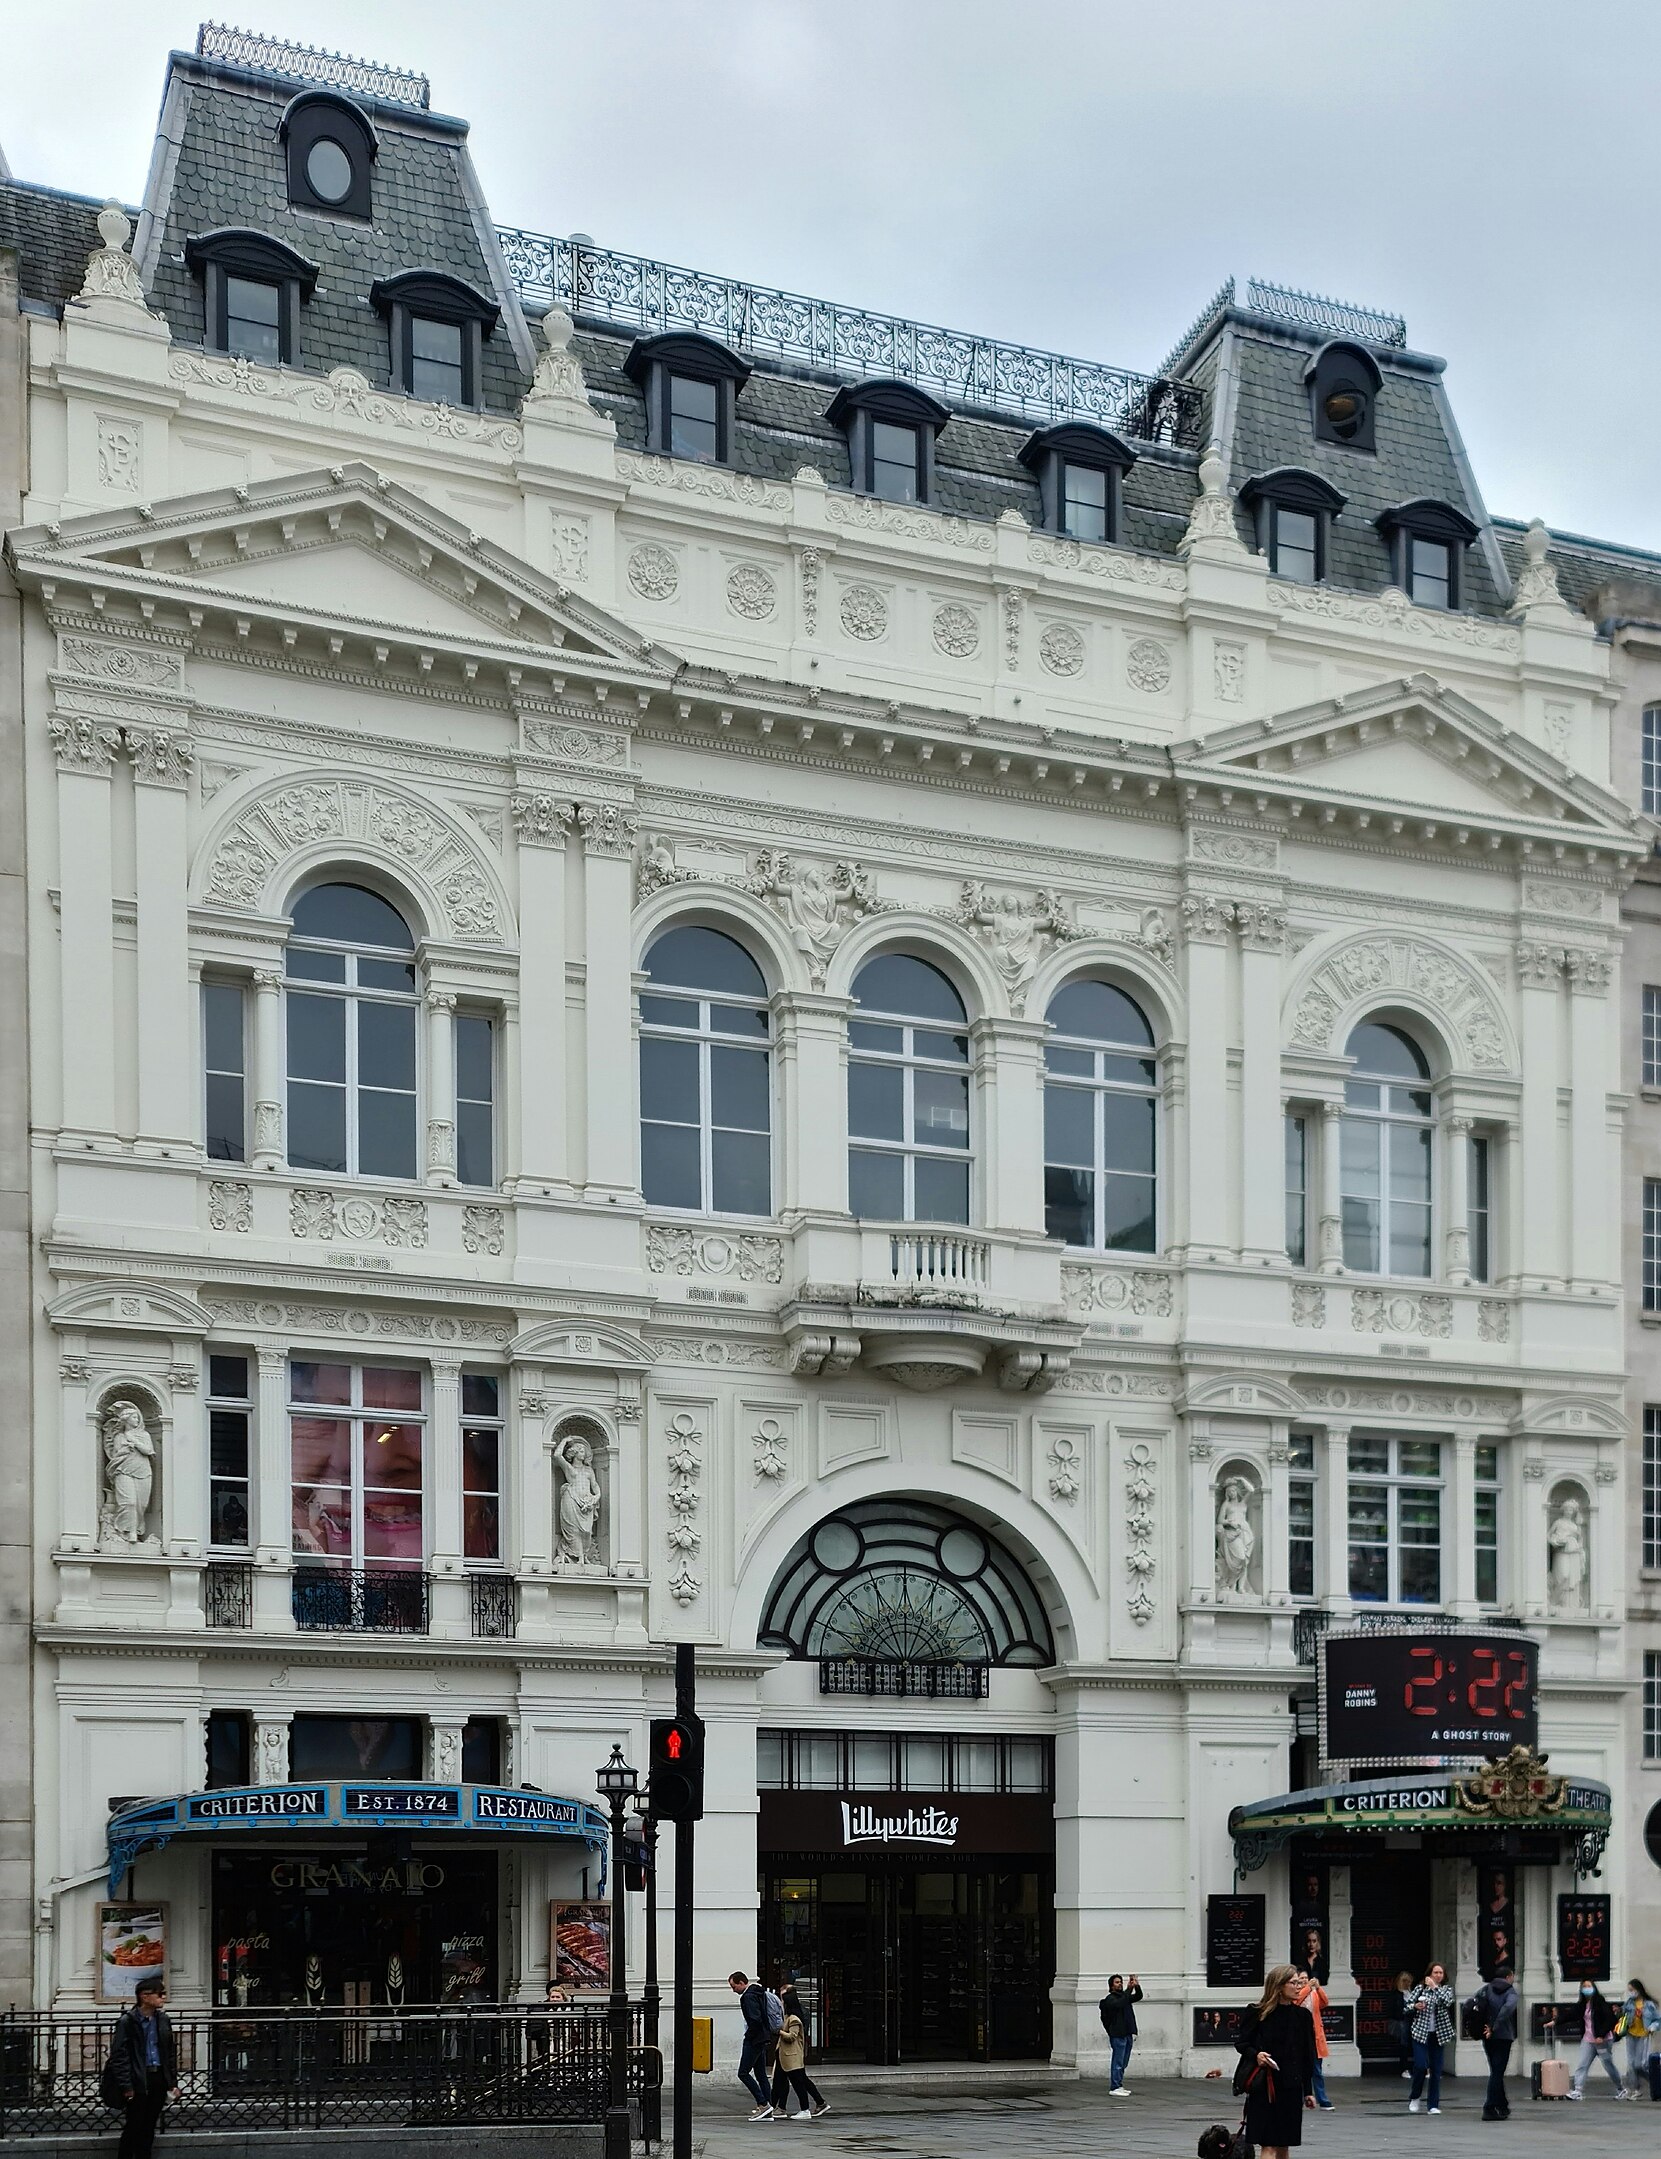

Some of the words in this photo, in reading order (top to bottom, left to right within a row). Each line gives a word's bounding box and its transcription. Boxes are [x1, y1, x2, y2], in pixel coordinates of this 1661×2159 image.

[1404, 1648, 1528, 1719] 2:22
[1344, 1698, 1377, 1708] ROBINS
[1345, 1689, 1375, 1699] DANNY
[1431, 1730, 1438, 1740] A
[1442, 1730, 1479, 1741] GHOST
[1482, 1730, 1511, 1742] STORY
[200, 1792, 317, 1816] CRITERION
[405, 1794, 448, 1811] 1874
[478, 1795, 576, 1821] RESTAURANT
[1343, 1789, 1447, 1811] CRITERION
[840, 1801, 960, 1846] Lillywhites
[226, 1932, 270, 1950] pasta
[449, 1931, 484, 1949] pizza
[1567, 1938, 1601, 1957] 2:22
[1362, 1956, 1388, 1969] YOU
[446, 1966, 486, 1991] grill
